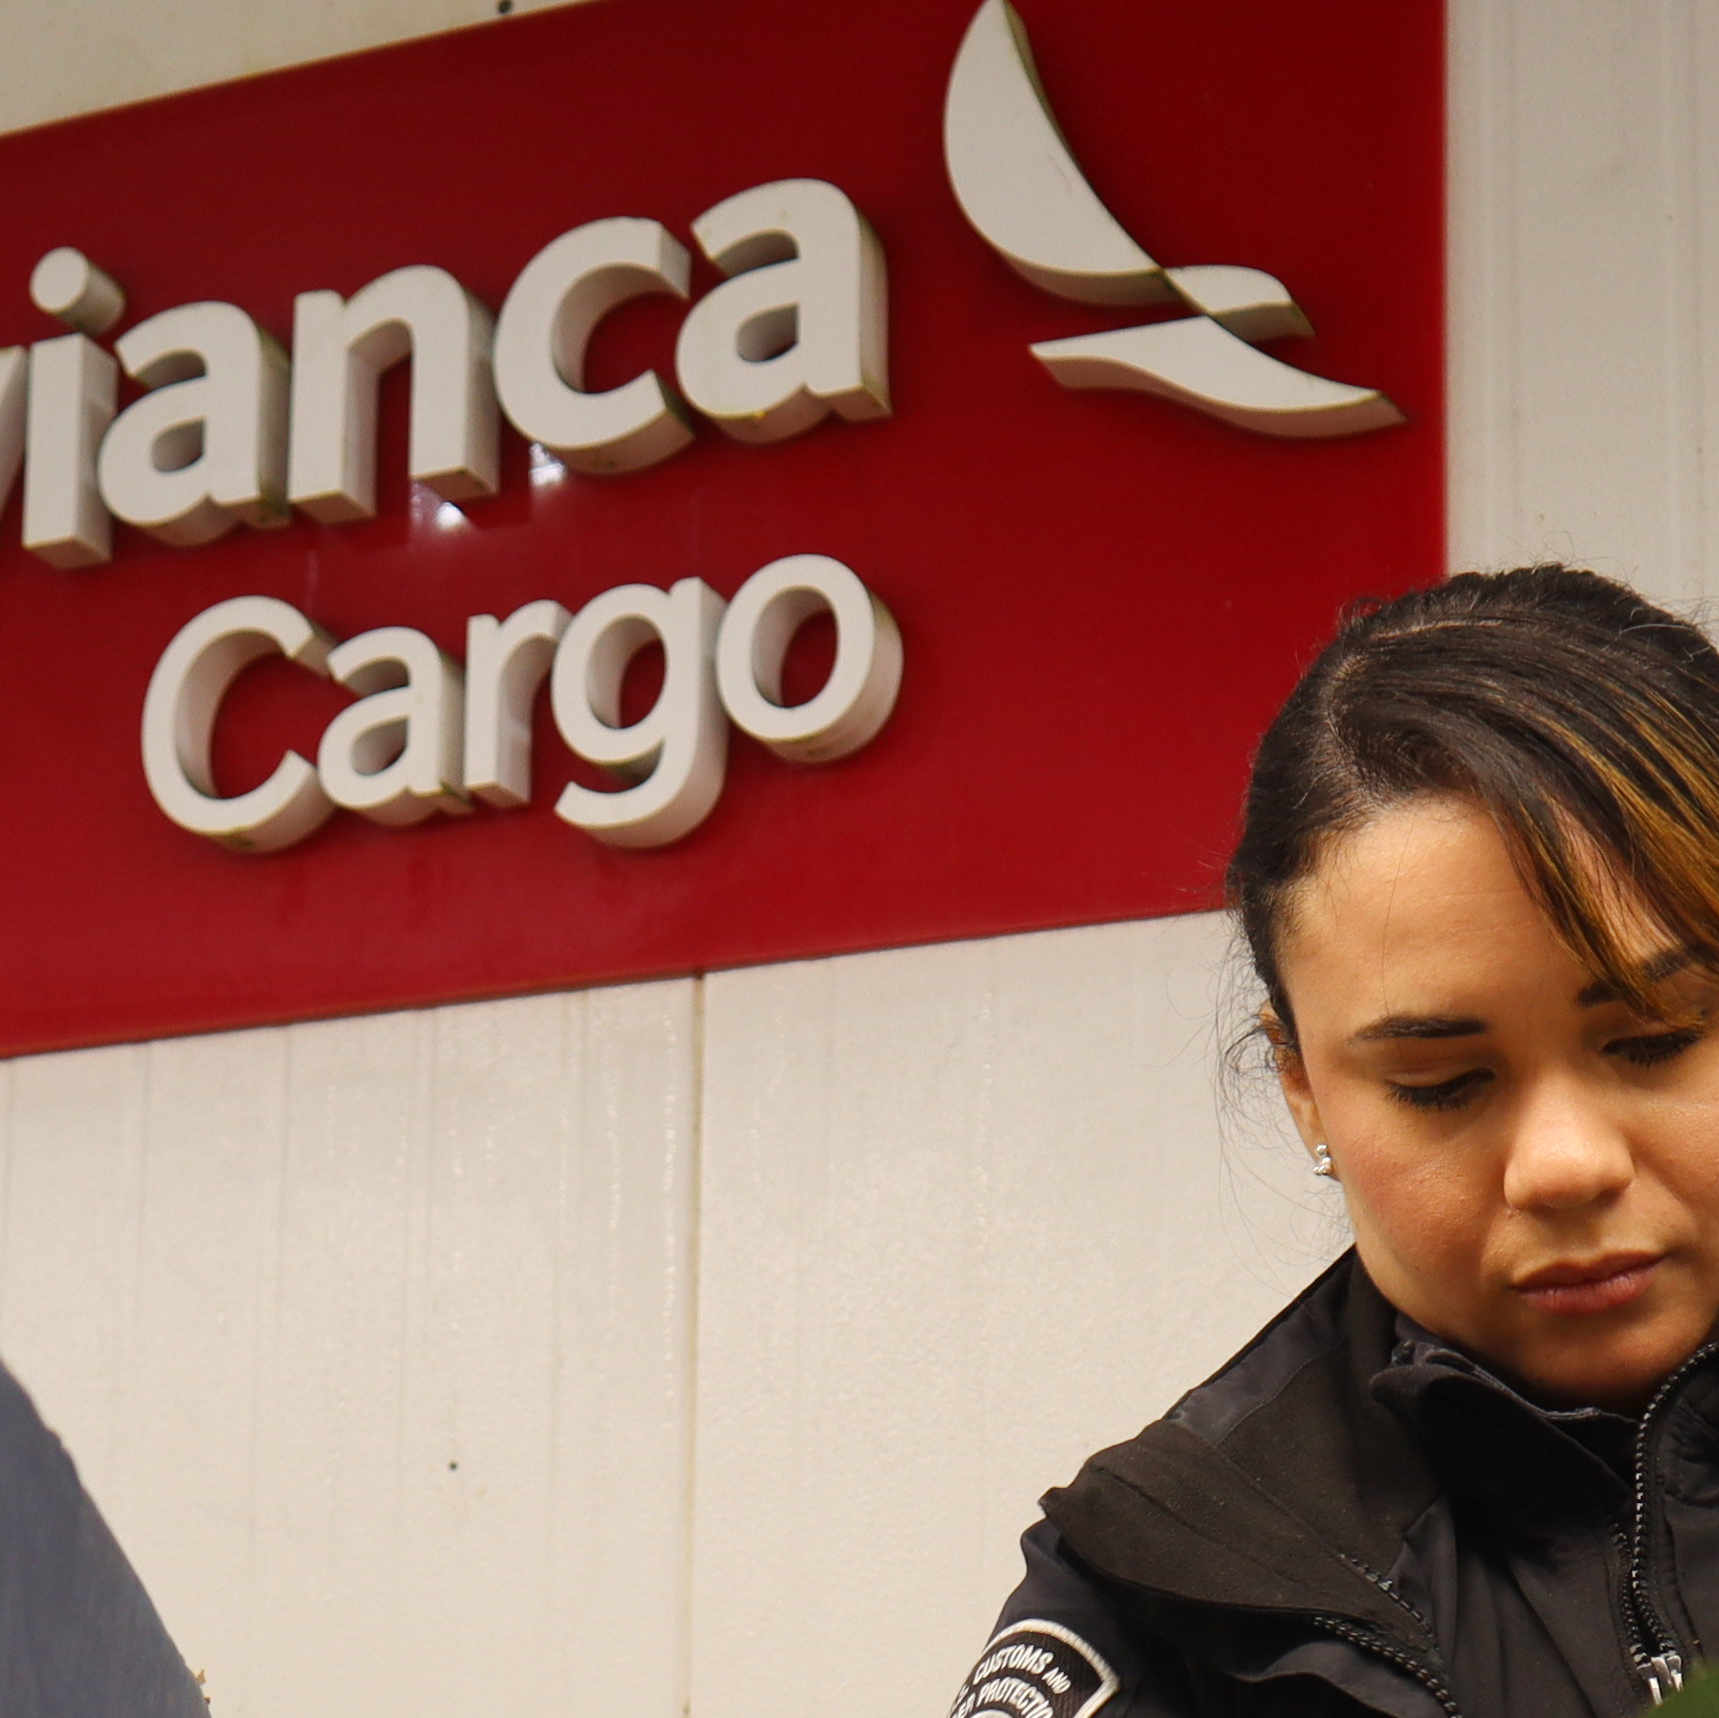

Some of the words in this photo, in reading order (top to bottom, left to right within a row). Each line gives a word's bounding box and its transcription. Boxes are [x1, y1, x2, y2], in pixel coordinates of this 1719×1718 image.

[142, 554, 904, 853] Cargo
[973, 1644, 1054, 1686] CUSTOMS
[1042, 1666, 1072, 1695] AND
